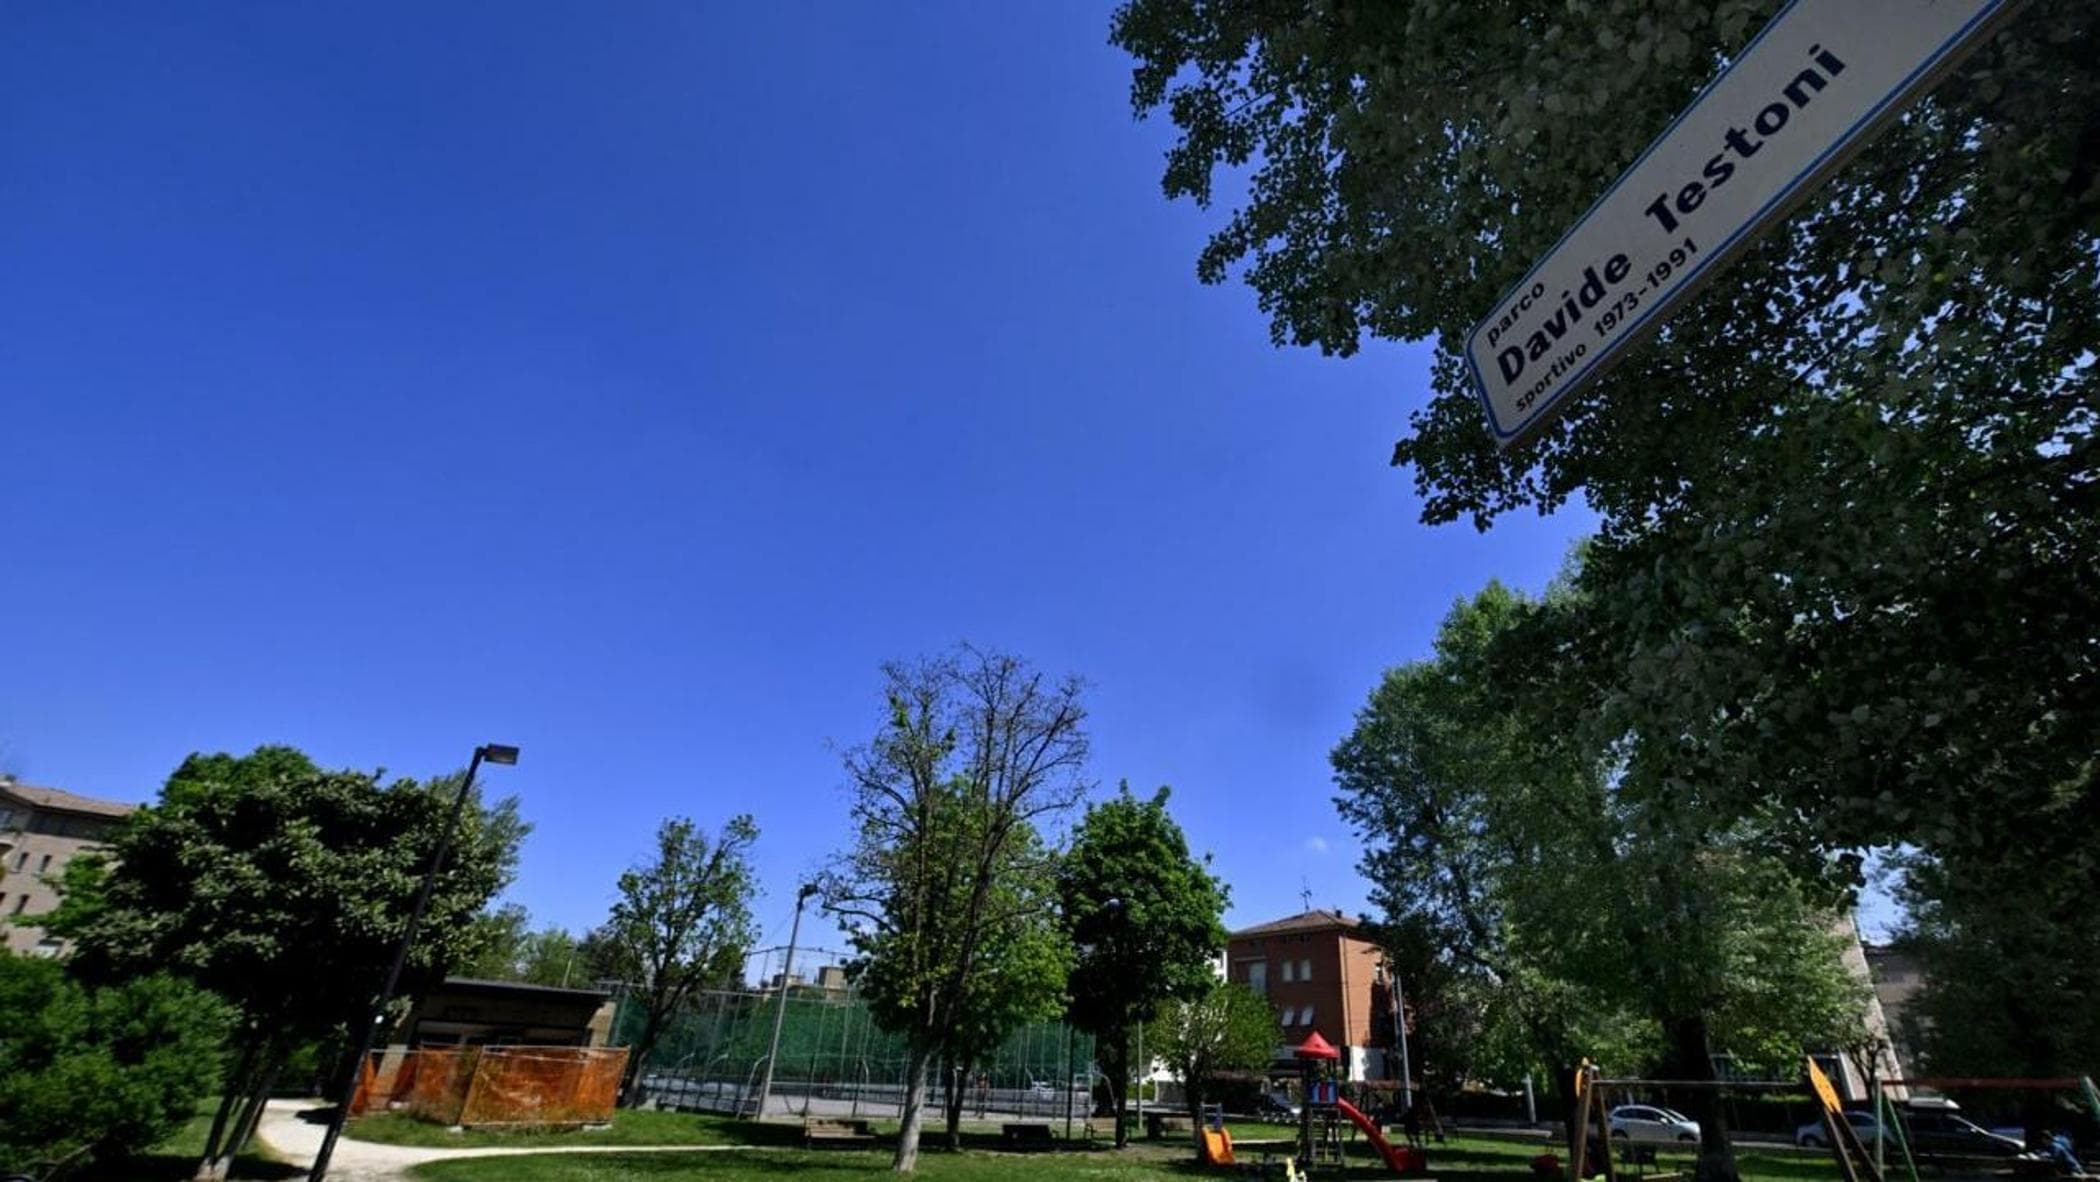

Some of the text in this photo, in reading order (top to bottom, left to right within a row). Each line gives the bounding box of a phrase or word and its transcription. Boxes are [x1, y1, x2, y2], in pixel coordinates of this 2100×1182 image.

[1497, 44, 1846, 385] Davide Testoni
[1487, 282, 1545, 347] parco
[1516, 237, 1698, 412] sportivo 1973-1991
